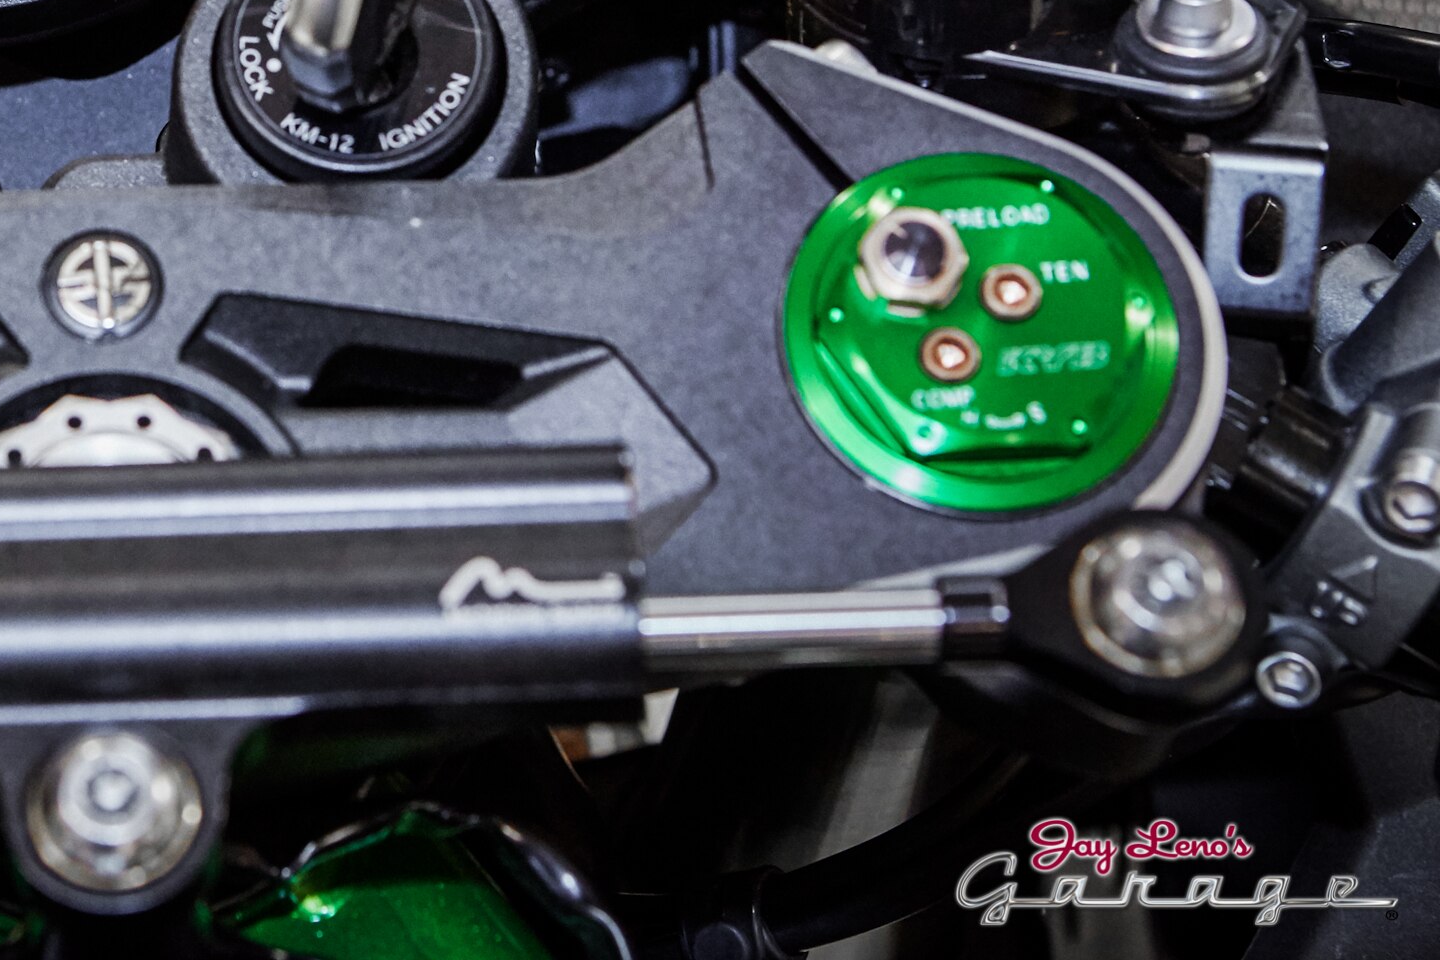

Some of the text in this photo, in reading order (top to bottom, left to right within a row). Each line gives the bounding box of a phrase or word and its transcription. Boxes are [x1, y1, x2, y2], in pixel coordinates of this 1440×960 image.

[239, 36, 273, 101] LOCK
[280, 112, 355, 153] KM-12
[378, 72, 471, 150] IGNITION
[1040, 260, 1090, 283] TEN
